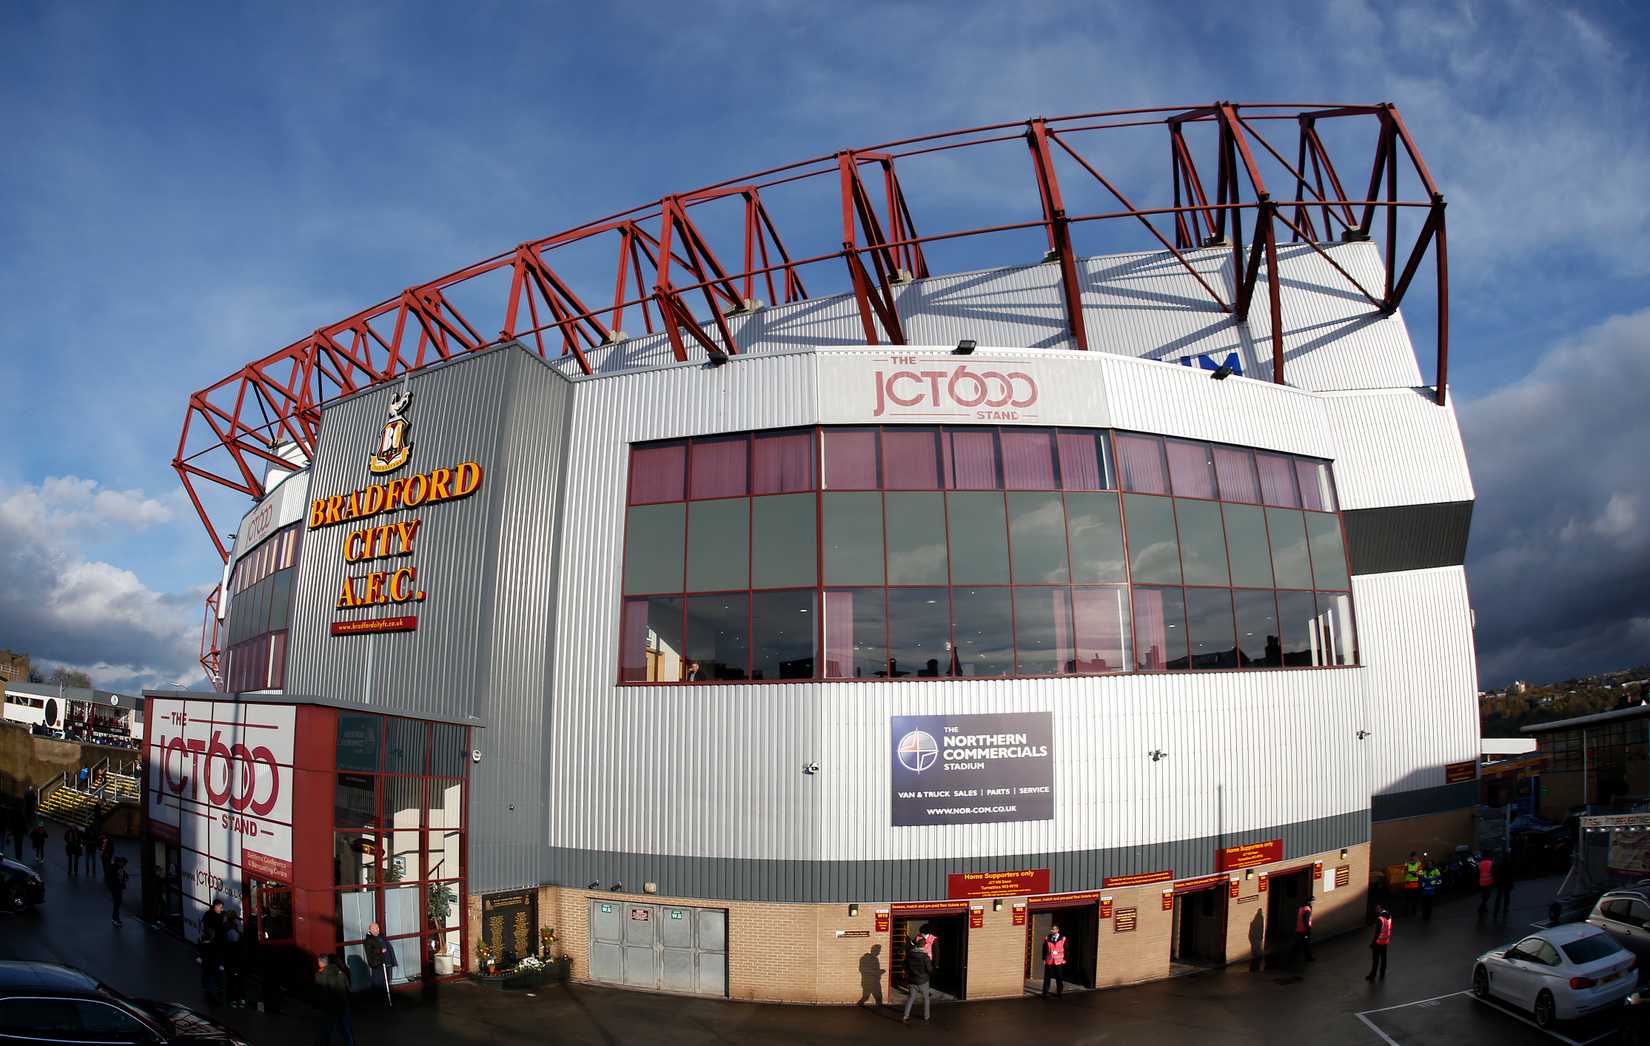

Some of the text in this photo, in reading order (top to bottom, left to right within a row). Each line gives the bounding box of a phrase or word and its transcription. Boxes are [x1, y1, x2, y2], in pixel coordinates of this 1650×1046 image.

[890, 356, 917, 365] THE
[873, 365, 1039, 417] JCT600
[976, 411, 1020, 420] STAND
[309, 461, 483, 529] BRADFORD
[343, 519, 421, 564] CITY
[336, 568, 426, 608] A.F.C.
[338, 619, 404, 631] www.bradfordcityfc.co.uk
[171, 711, 187, 727] THE
[943, 733, 1027, 747] NORTHERN
[943, 745, 1048, 760] COMMERCIALS
[157, 730, 279, 816] JCT600
[943, 762, 985, 771] STADIUM
[898, 791, 916, 799] VAN
[923, 790, 951, 799] TRUCK
[953, 789, 977, 797] SALES
[986, 788, 1010, 796] PARTS
[1019, 786, 1050, 794] SERVICE
[926, 805, 1017, 816] WWW.NOR-COM.CO.UK
[222, 813, 258, 837] STAND
[984, 872, 1020, 880] Supporters
[1020, 870, 1035, 878] only
